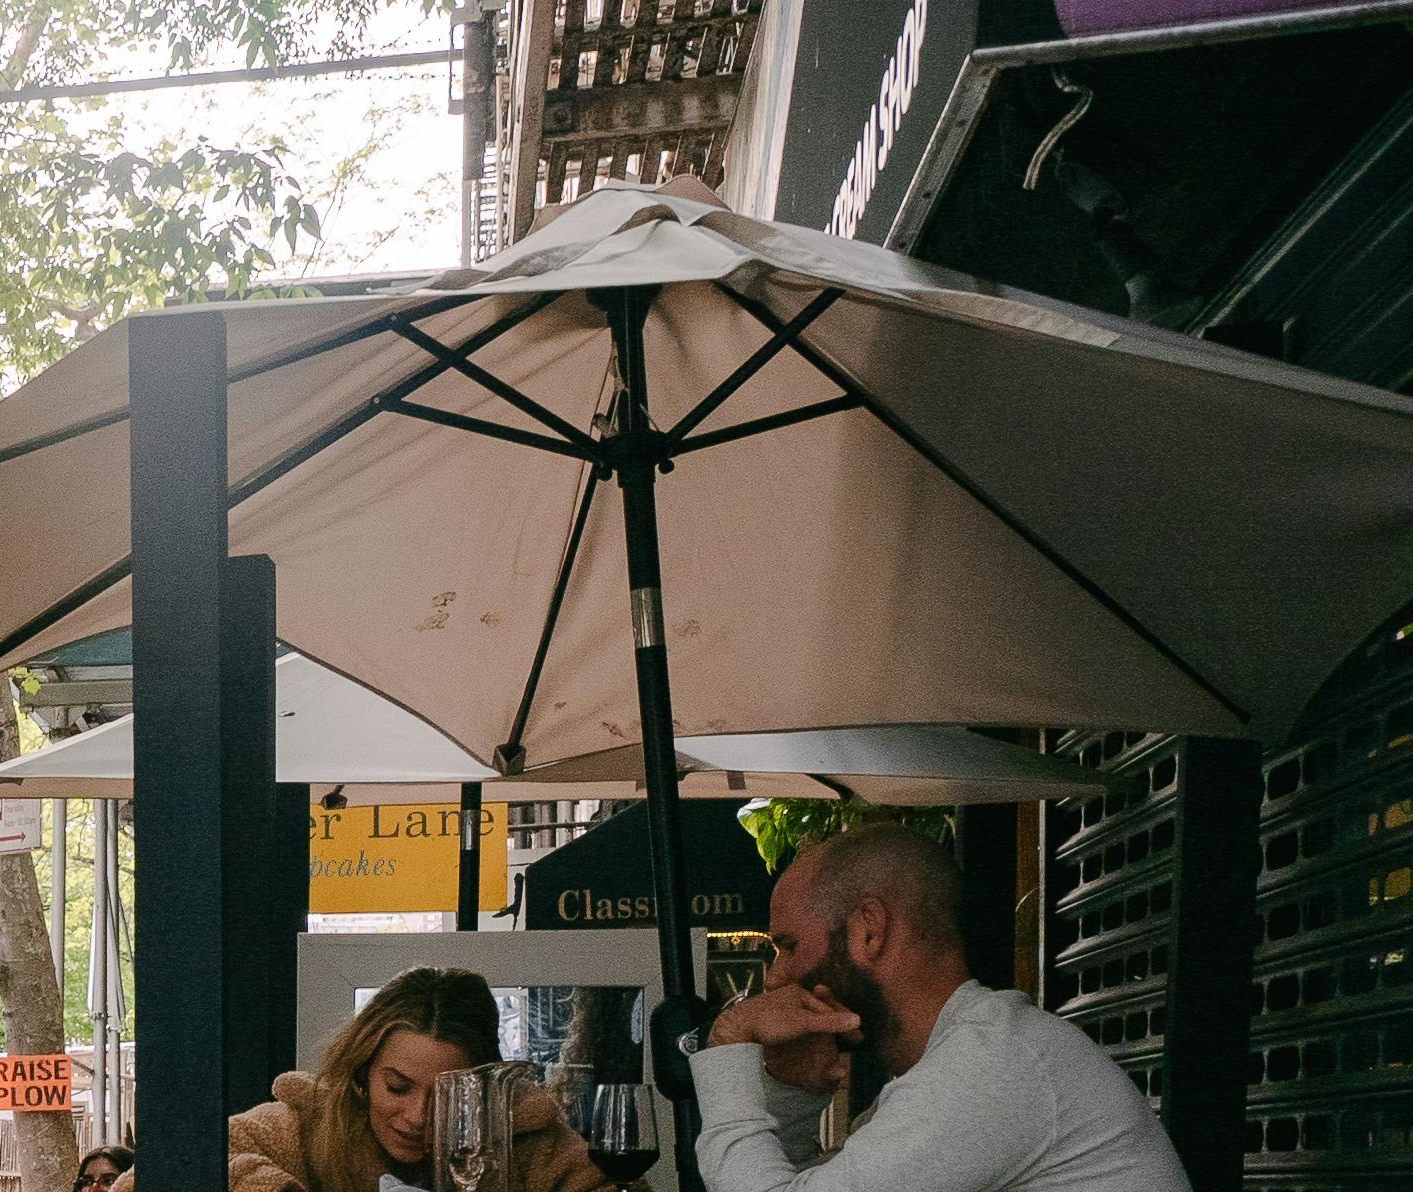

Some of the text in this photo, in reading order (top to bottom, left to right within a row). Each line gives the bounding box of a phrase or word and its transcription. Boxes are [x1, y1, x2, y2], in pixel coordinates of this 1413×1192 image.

[877, 0, 928, 171] SHOP
[368, 805, 494, 839] Lane
[557, 889, 744, 922] Classom
